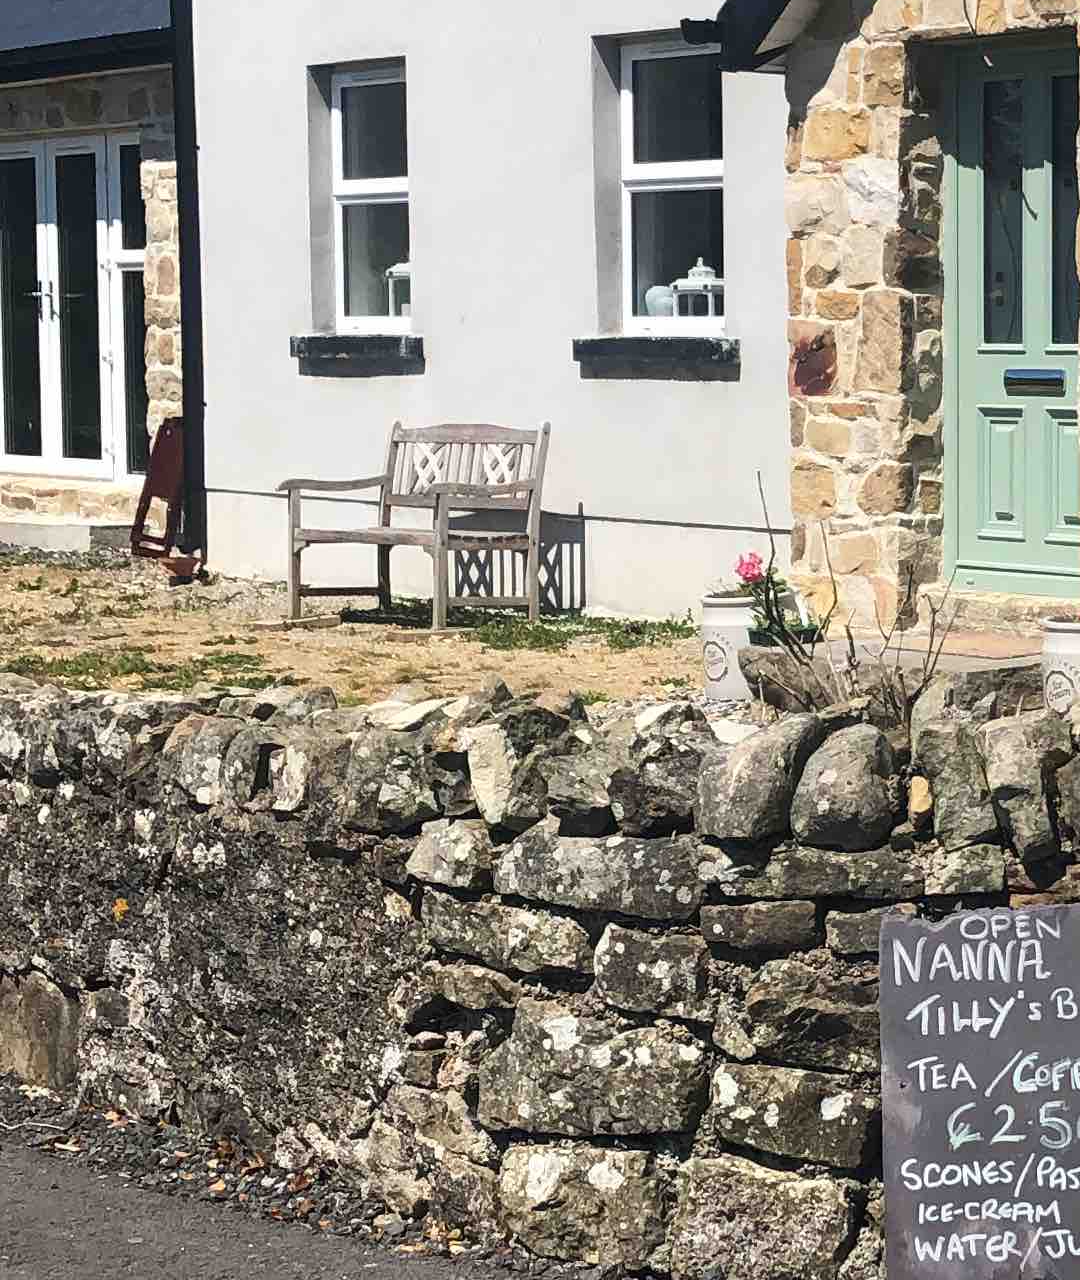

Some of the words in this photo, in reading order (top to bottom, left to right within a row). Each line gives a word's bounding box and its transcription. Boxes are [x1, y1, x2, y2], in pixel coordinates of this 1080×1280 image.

[959, 914, 1061, 940] OPEN
[892, 936, 1052, 986] NANNA
[918, 1198, 1061, 1225] ICE-CREAM
